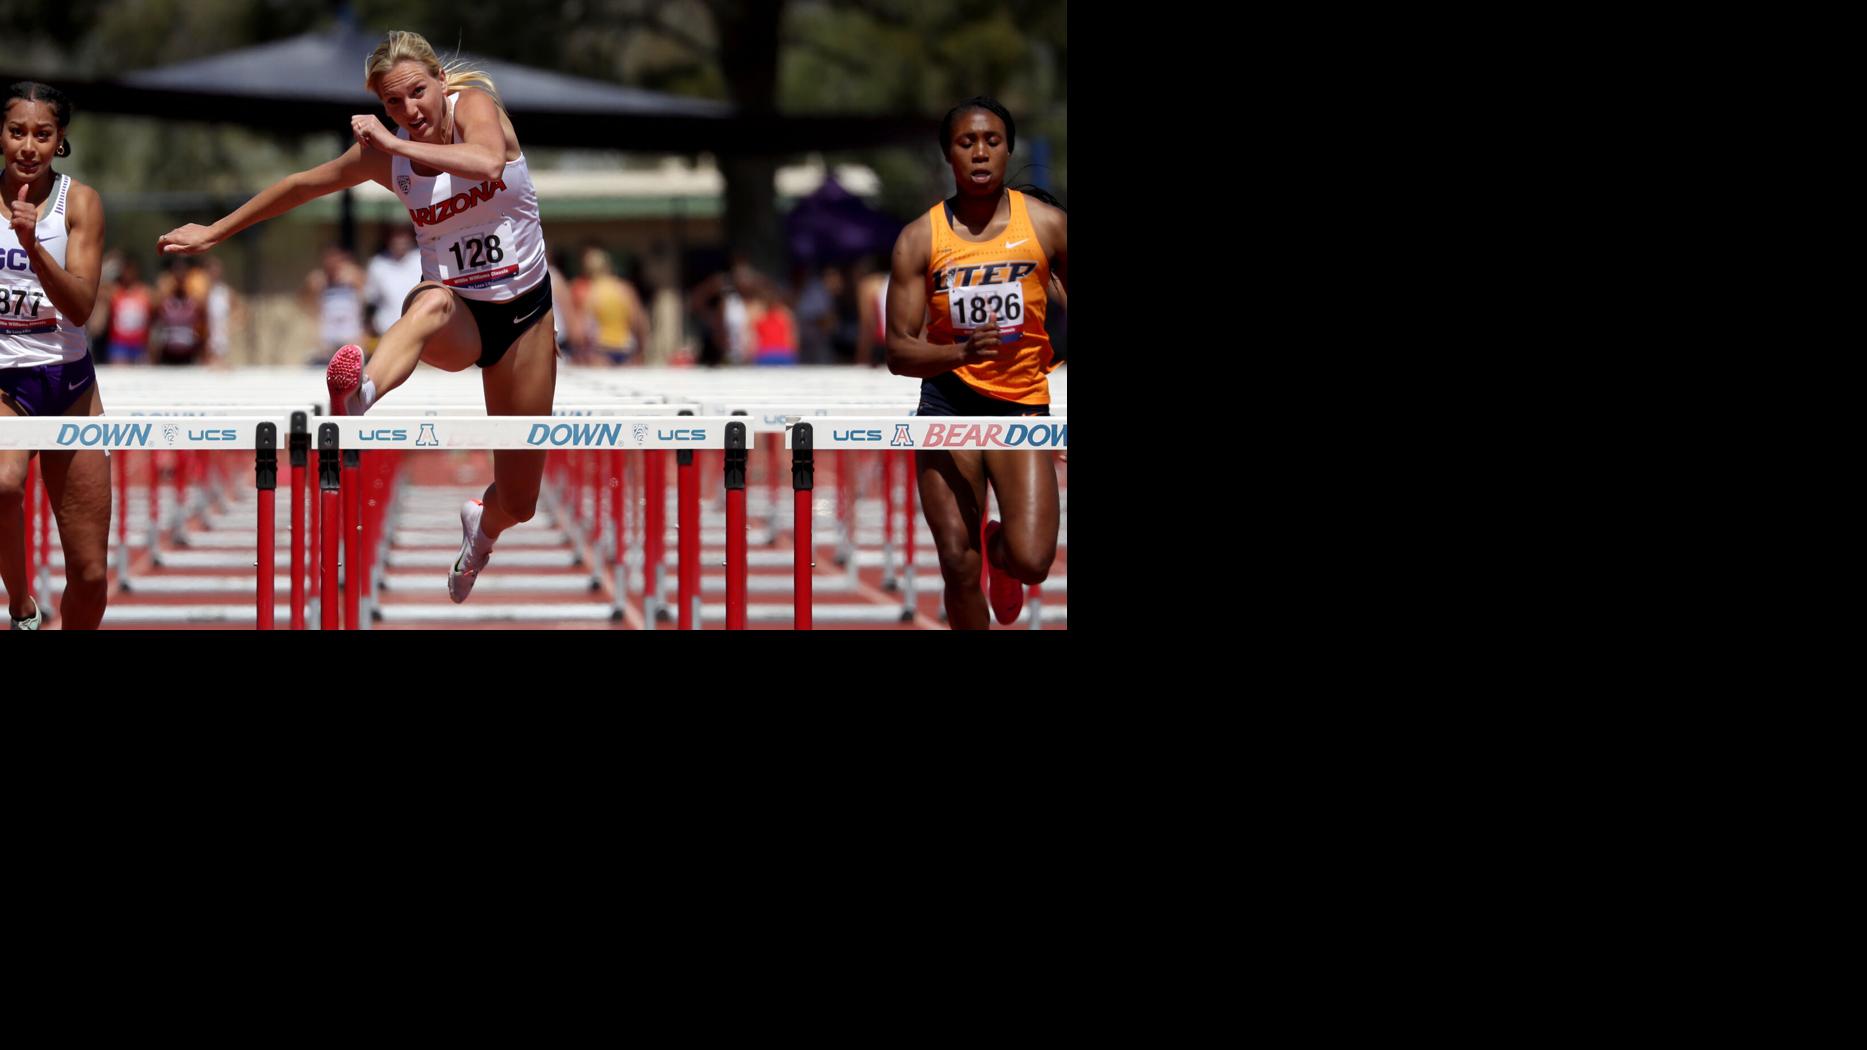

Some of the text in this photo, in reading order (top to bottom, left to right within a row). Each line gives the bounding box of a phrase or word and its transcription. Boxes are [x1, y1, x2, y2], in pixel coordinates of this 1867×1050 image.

[449, 235, 504, 271] 128
[932, 260, 1039, 293] UTEP
[953, 293, 1020, 323] 1826
[56, 423, 152, 446] DOWN
[188, 429, 237, 441] UCS
[359, 429, 407, 441] UCS
[527, 423, 622, 446] DOWN
[658, 429, 706, 441] UCS
[833, 430, 882, 441] UCS
